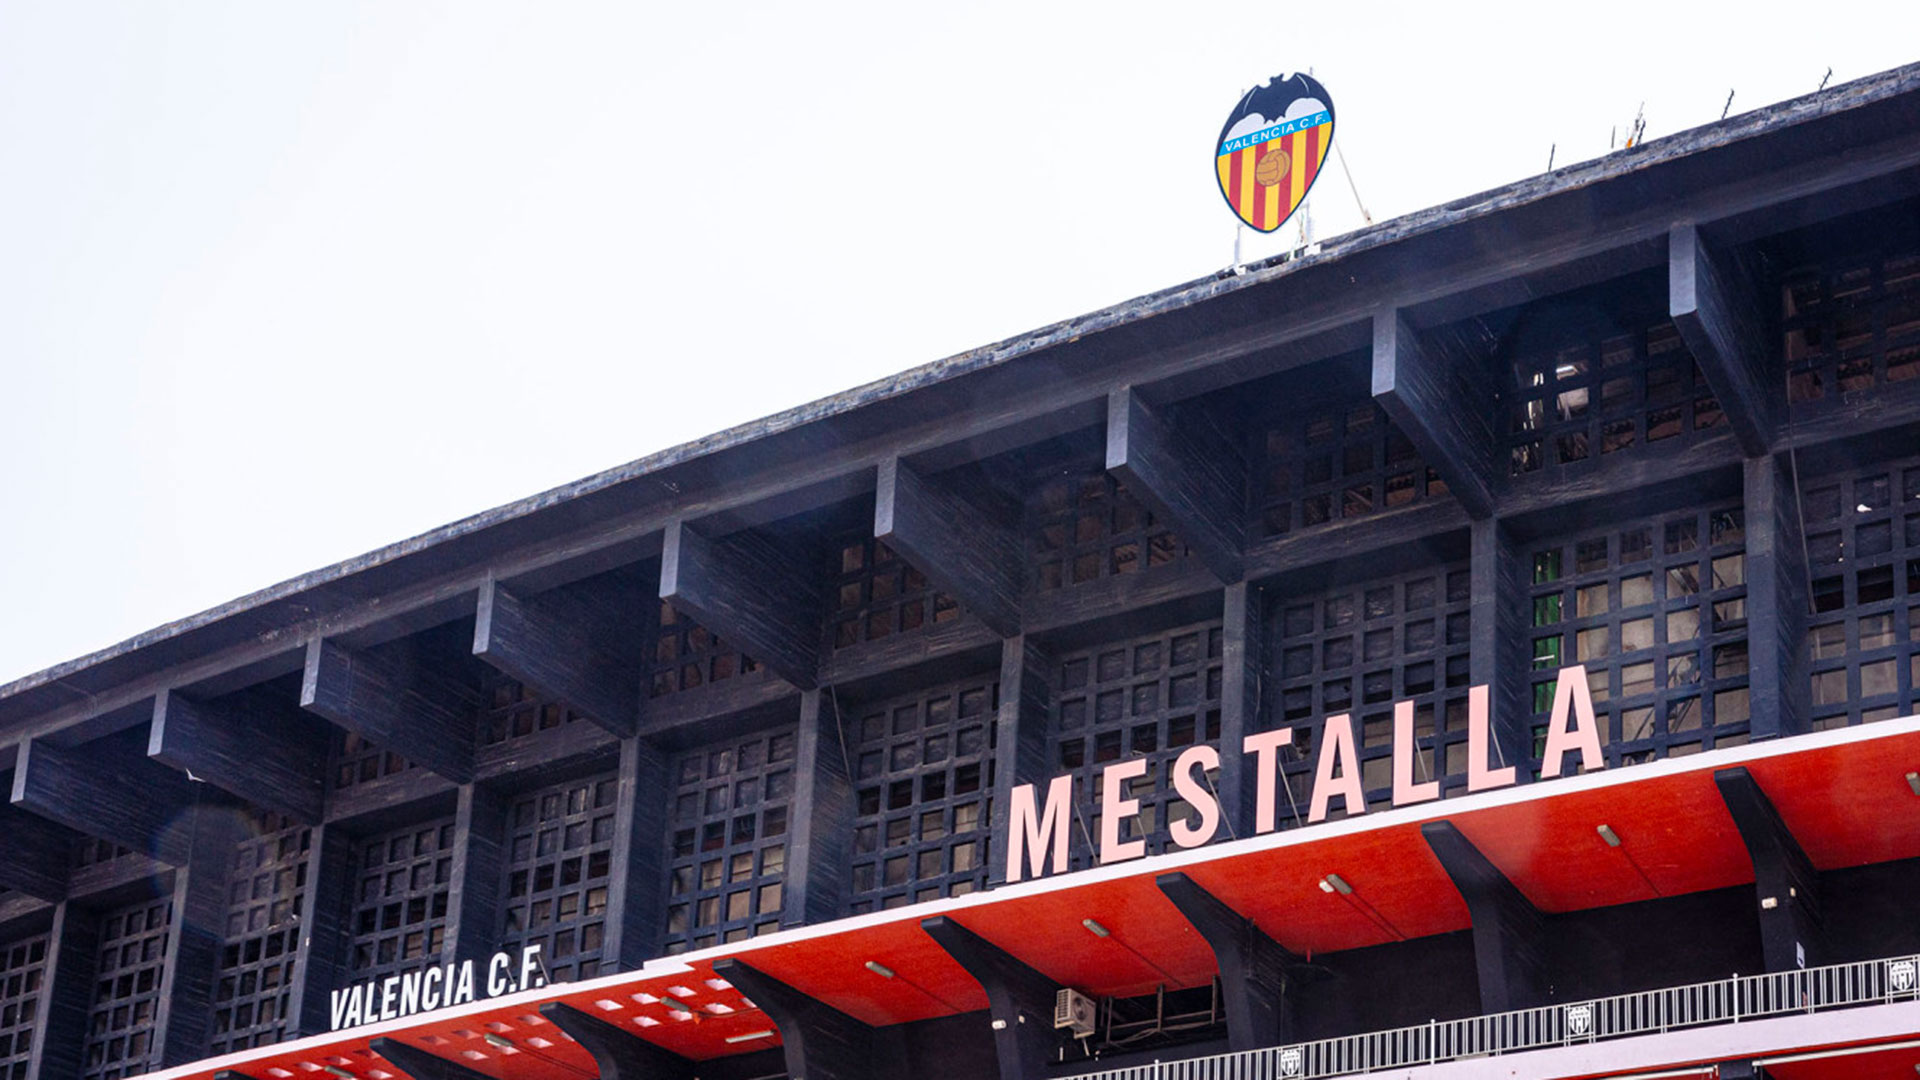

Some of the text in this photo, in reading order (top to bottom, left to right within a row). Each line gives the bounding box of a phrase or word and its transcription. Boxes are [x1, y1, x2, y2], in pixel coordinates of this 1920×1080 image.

[1225, 114, 1326, 151] VALENCIA C.F.
[1006, 664, 1605, 882] MESTALLA
[331, 944, 543, 1031] VALENCIA C.F.
